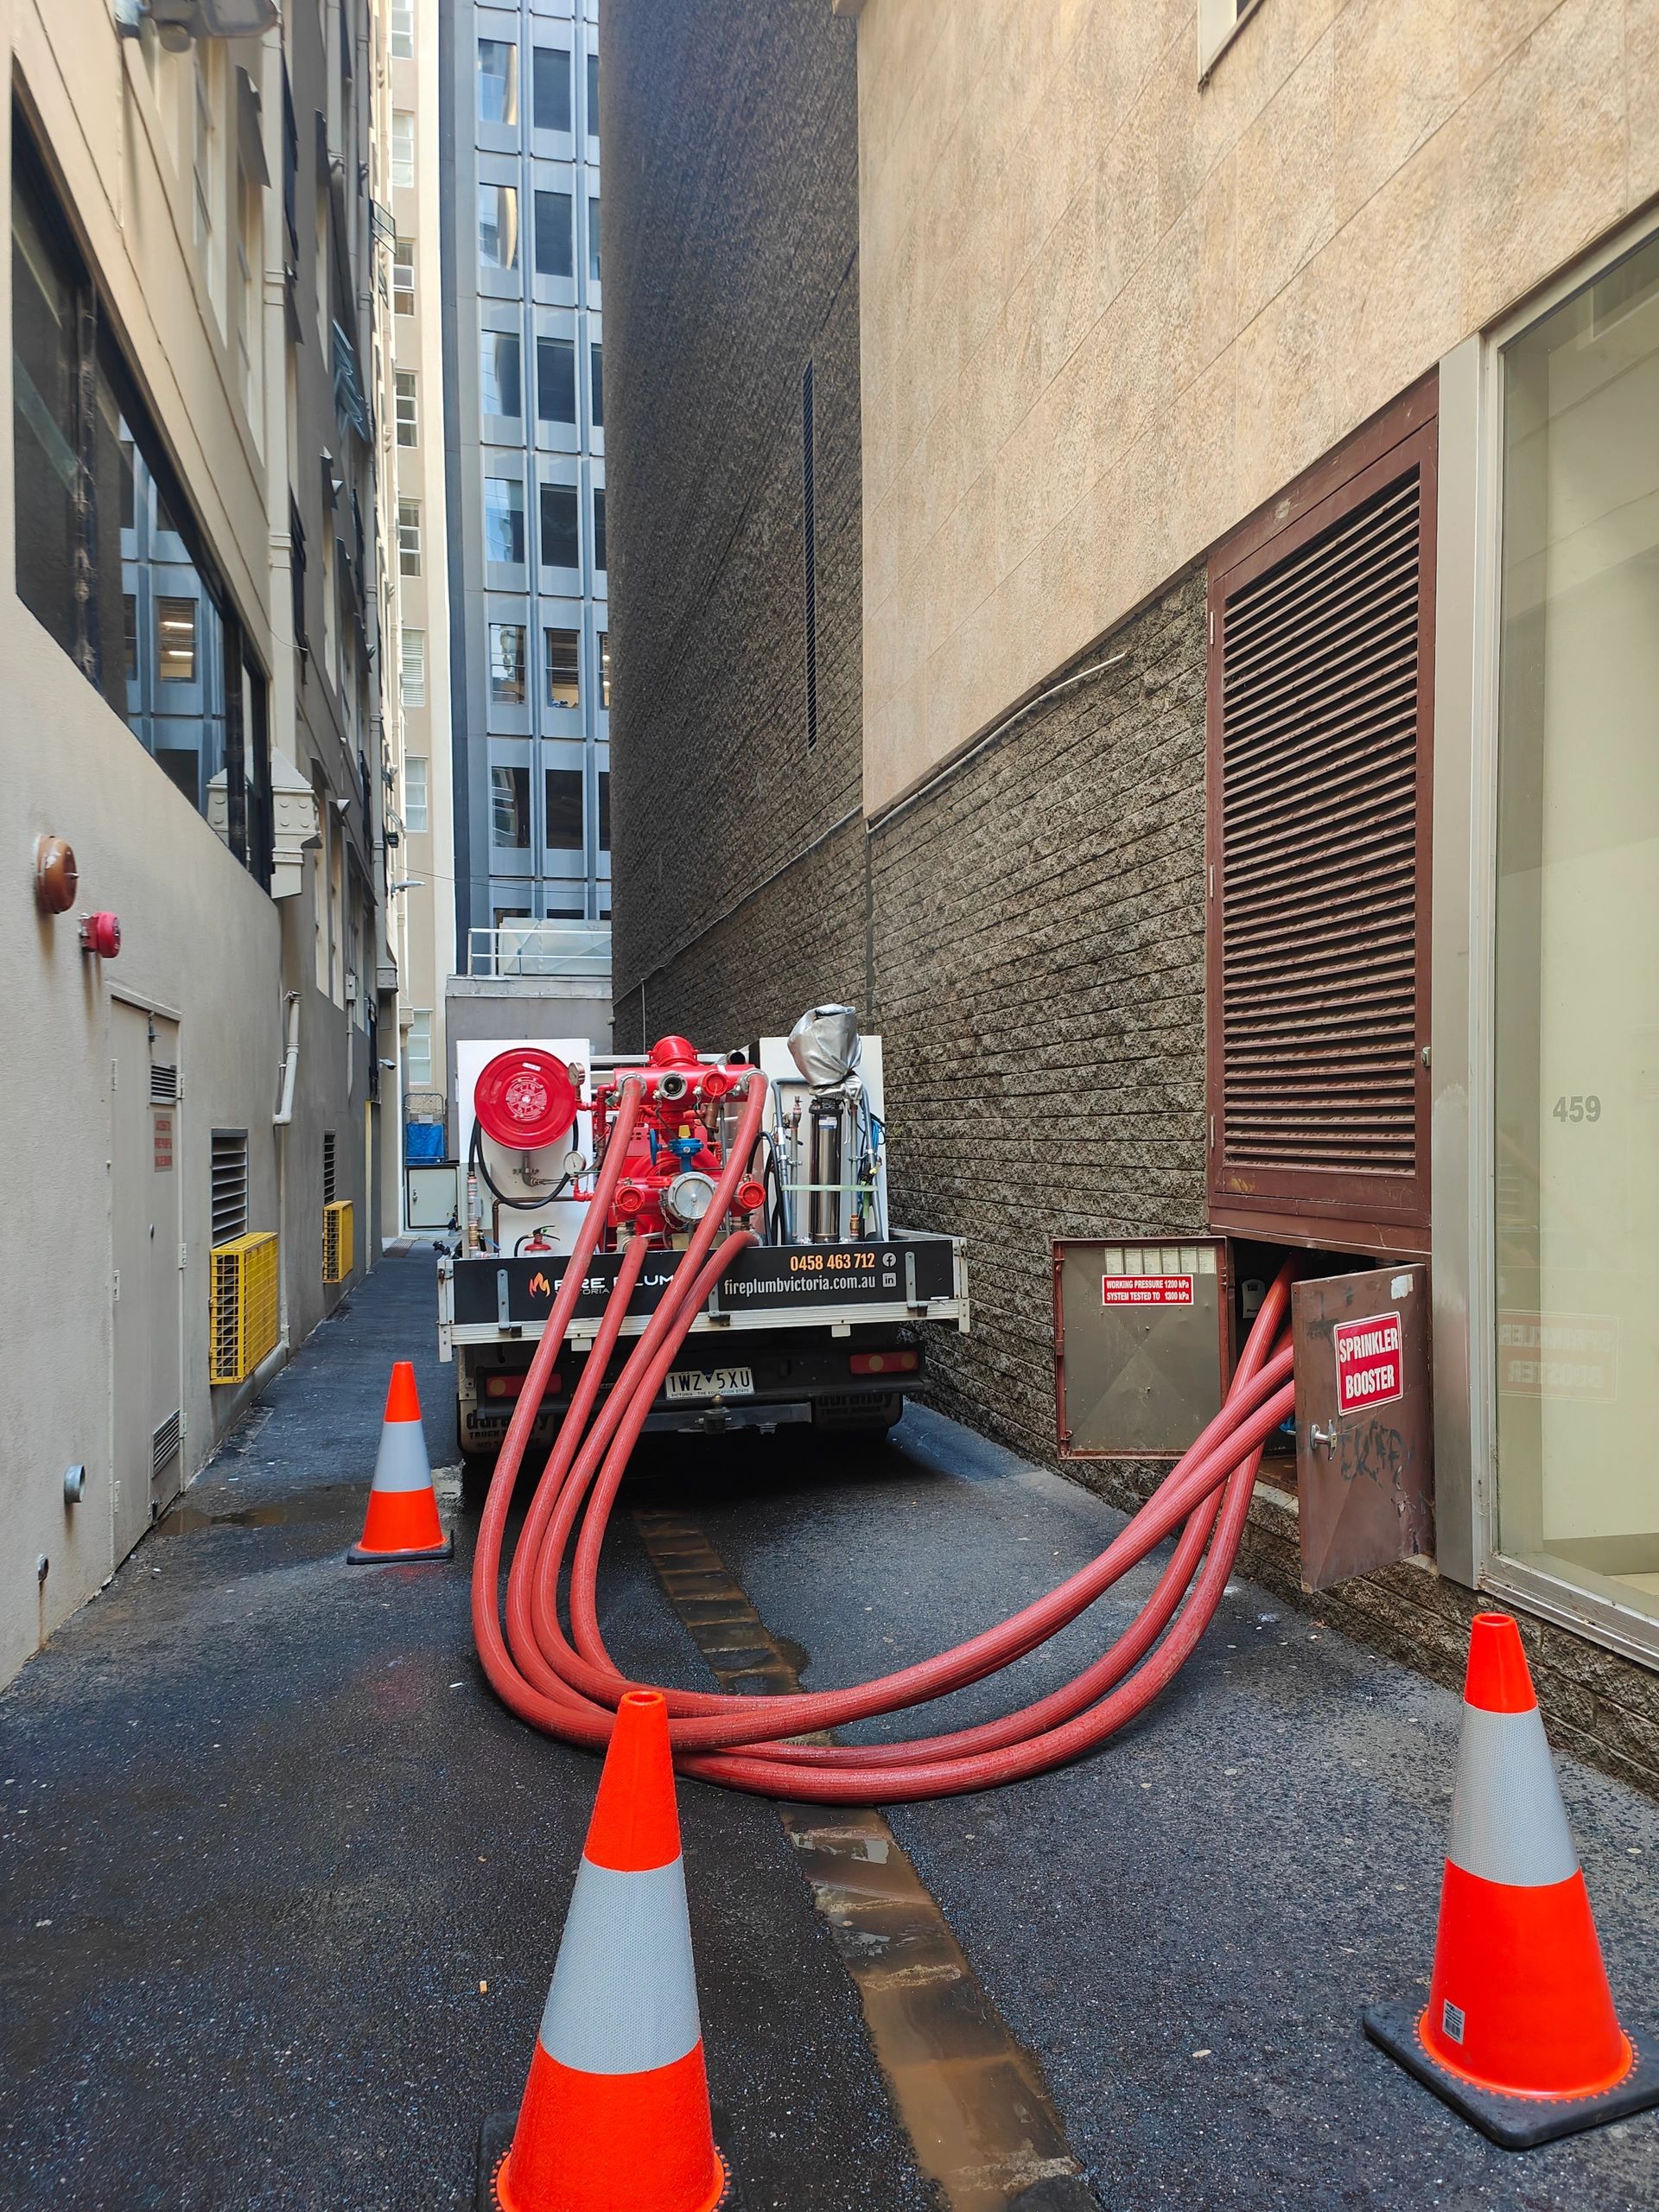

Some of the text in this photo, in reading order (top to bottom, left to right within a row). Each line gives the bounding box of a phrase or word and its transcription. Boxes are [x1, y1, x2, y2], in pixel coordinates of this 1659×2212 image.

[1553, 1095, 1601, 1122] 459
[790, 1252, 875, 1271] 0458 463 712
[554, 1278, 606, 1290] FRE
[724, 1274, 876, 1296] fireplumbvictoria.com.au
[1106, 1279, 1190, 1289] WORKING PRESSURE 1200 kPa
[1106, 1291, 1190, 1301] SYSTEM TESTED TO 1300 kPa
[1338, 1327, 1399, 1363] SPRINKLER
[670, 1371, 750, 1392] 1WZ 5XU
[1345, 1364, 1395, 1400] BOOSTER
